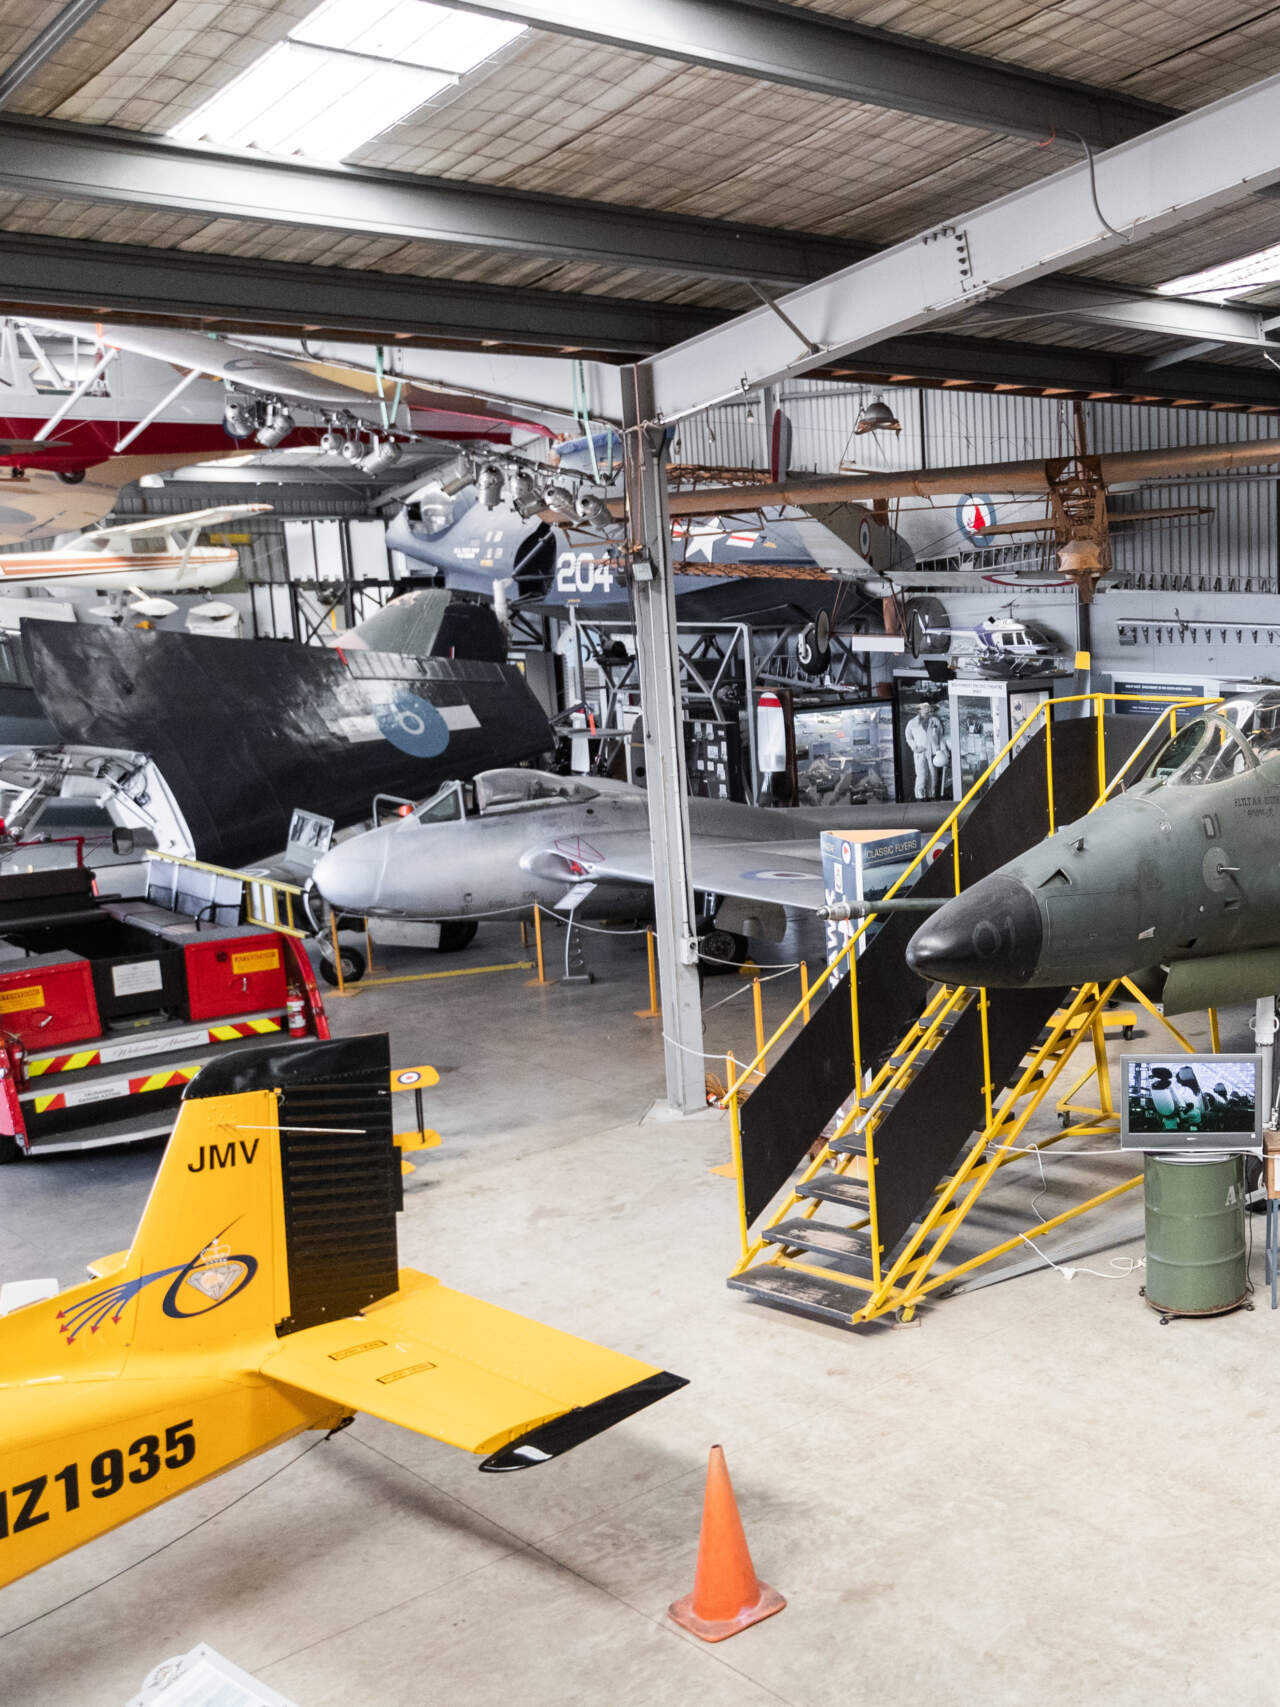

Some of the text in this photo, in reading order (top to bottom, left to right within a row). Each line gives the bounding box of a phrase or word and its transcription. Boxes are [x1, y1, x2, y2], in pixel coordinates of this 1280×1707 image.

[556, 551, 614, 593] 204
[866, 839, 918, 859] CLASSIC FLYERS
[187, 1138, 260, 1173] JMV
